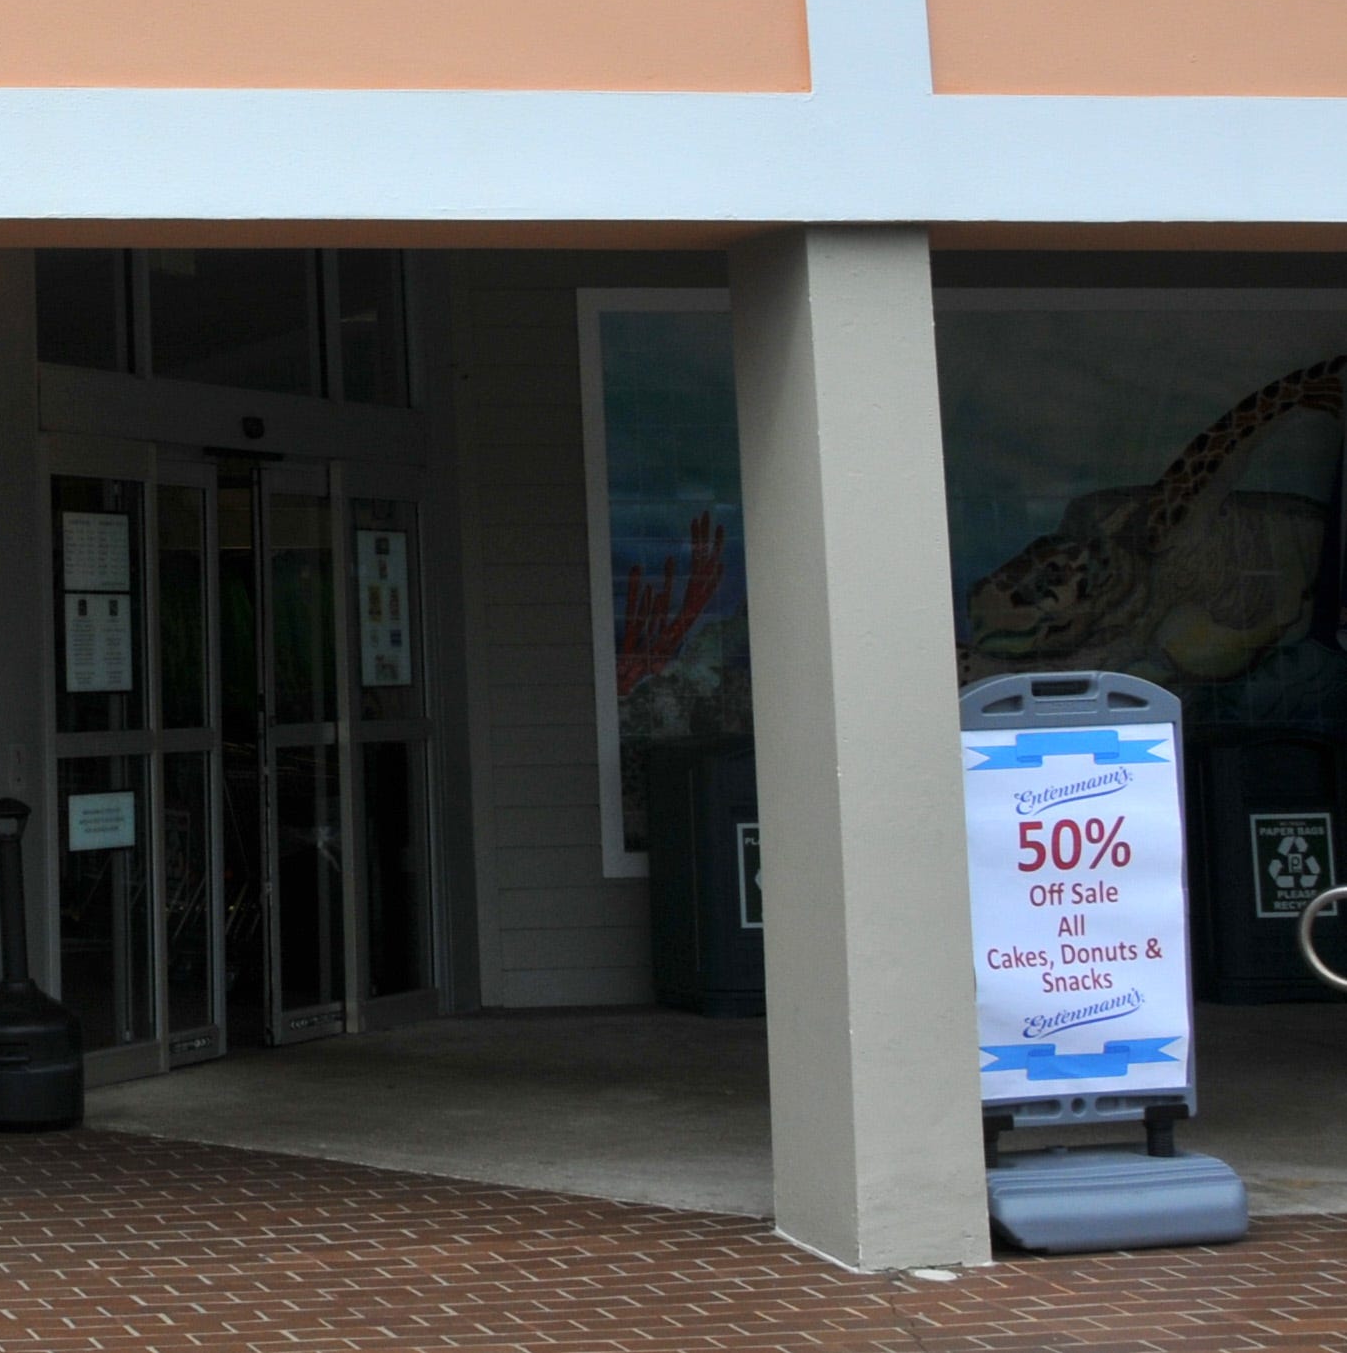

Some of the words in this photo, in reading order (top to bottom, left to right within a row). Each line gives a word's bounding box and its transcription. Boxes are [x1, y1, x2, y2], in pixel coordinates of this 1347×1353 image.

[1017, 815, 1132, 873] 50%
[1258, 827, 1295, 836] PAPER
[1297, 826, 1325, 836] BAGS
[1029, 882, 1065, 907] Off
[1071, 880, 1119, 905] Sale
[1272, 901, 1308, 911] RECY
[1057, 914, 1085, 938] All
[987, 945, 1055, 970] Cakes,
[1060, 941, 1138, 965] Donuts
[1144, 937, 1163, 960] &
[1042, 967, 1113, 993] Snacks
